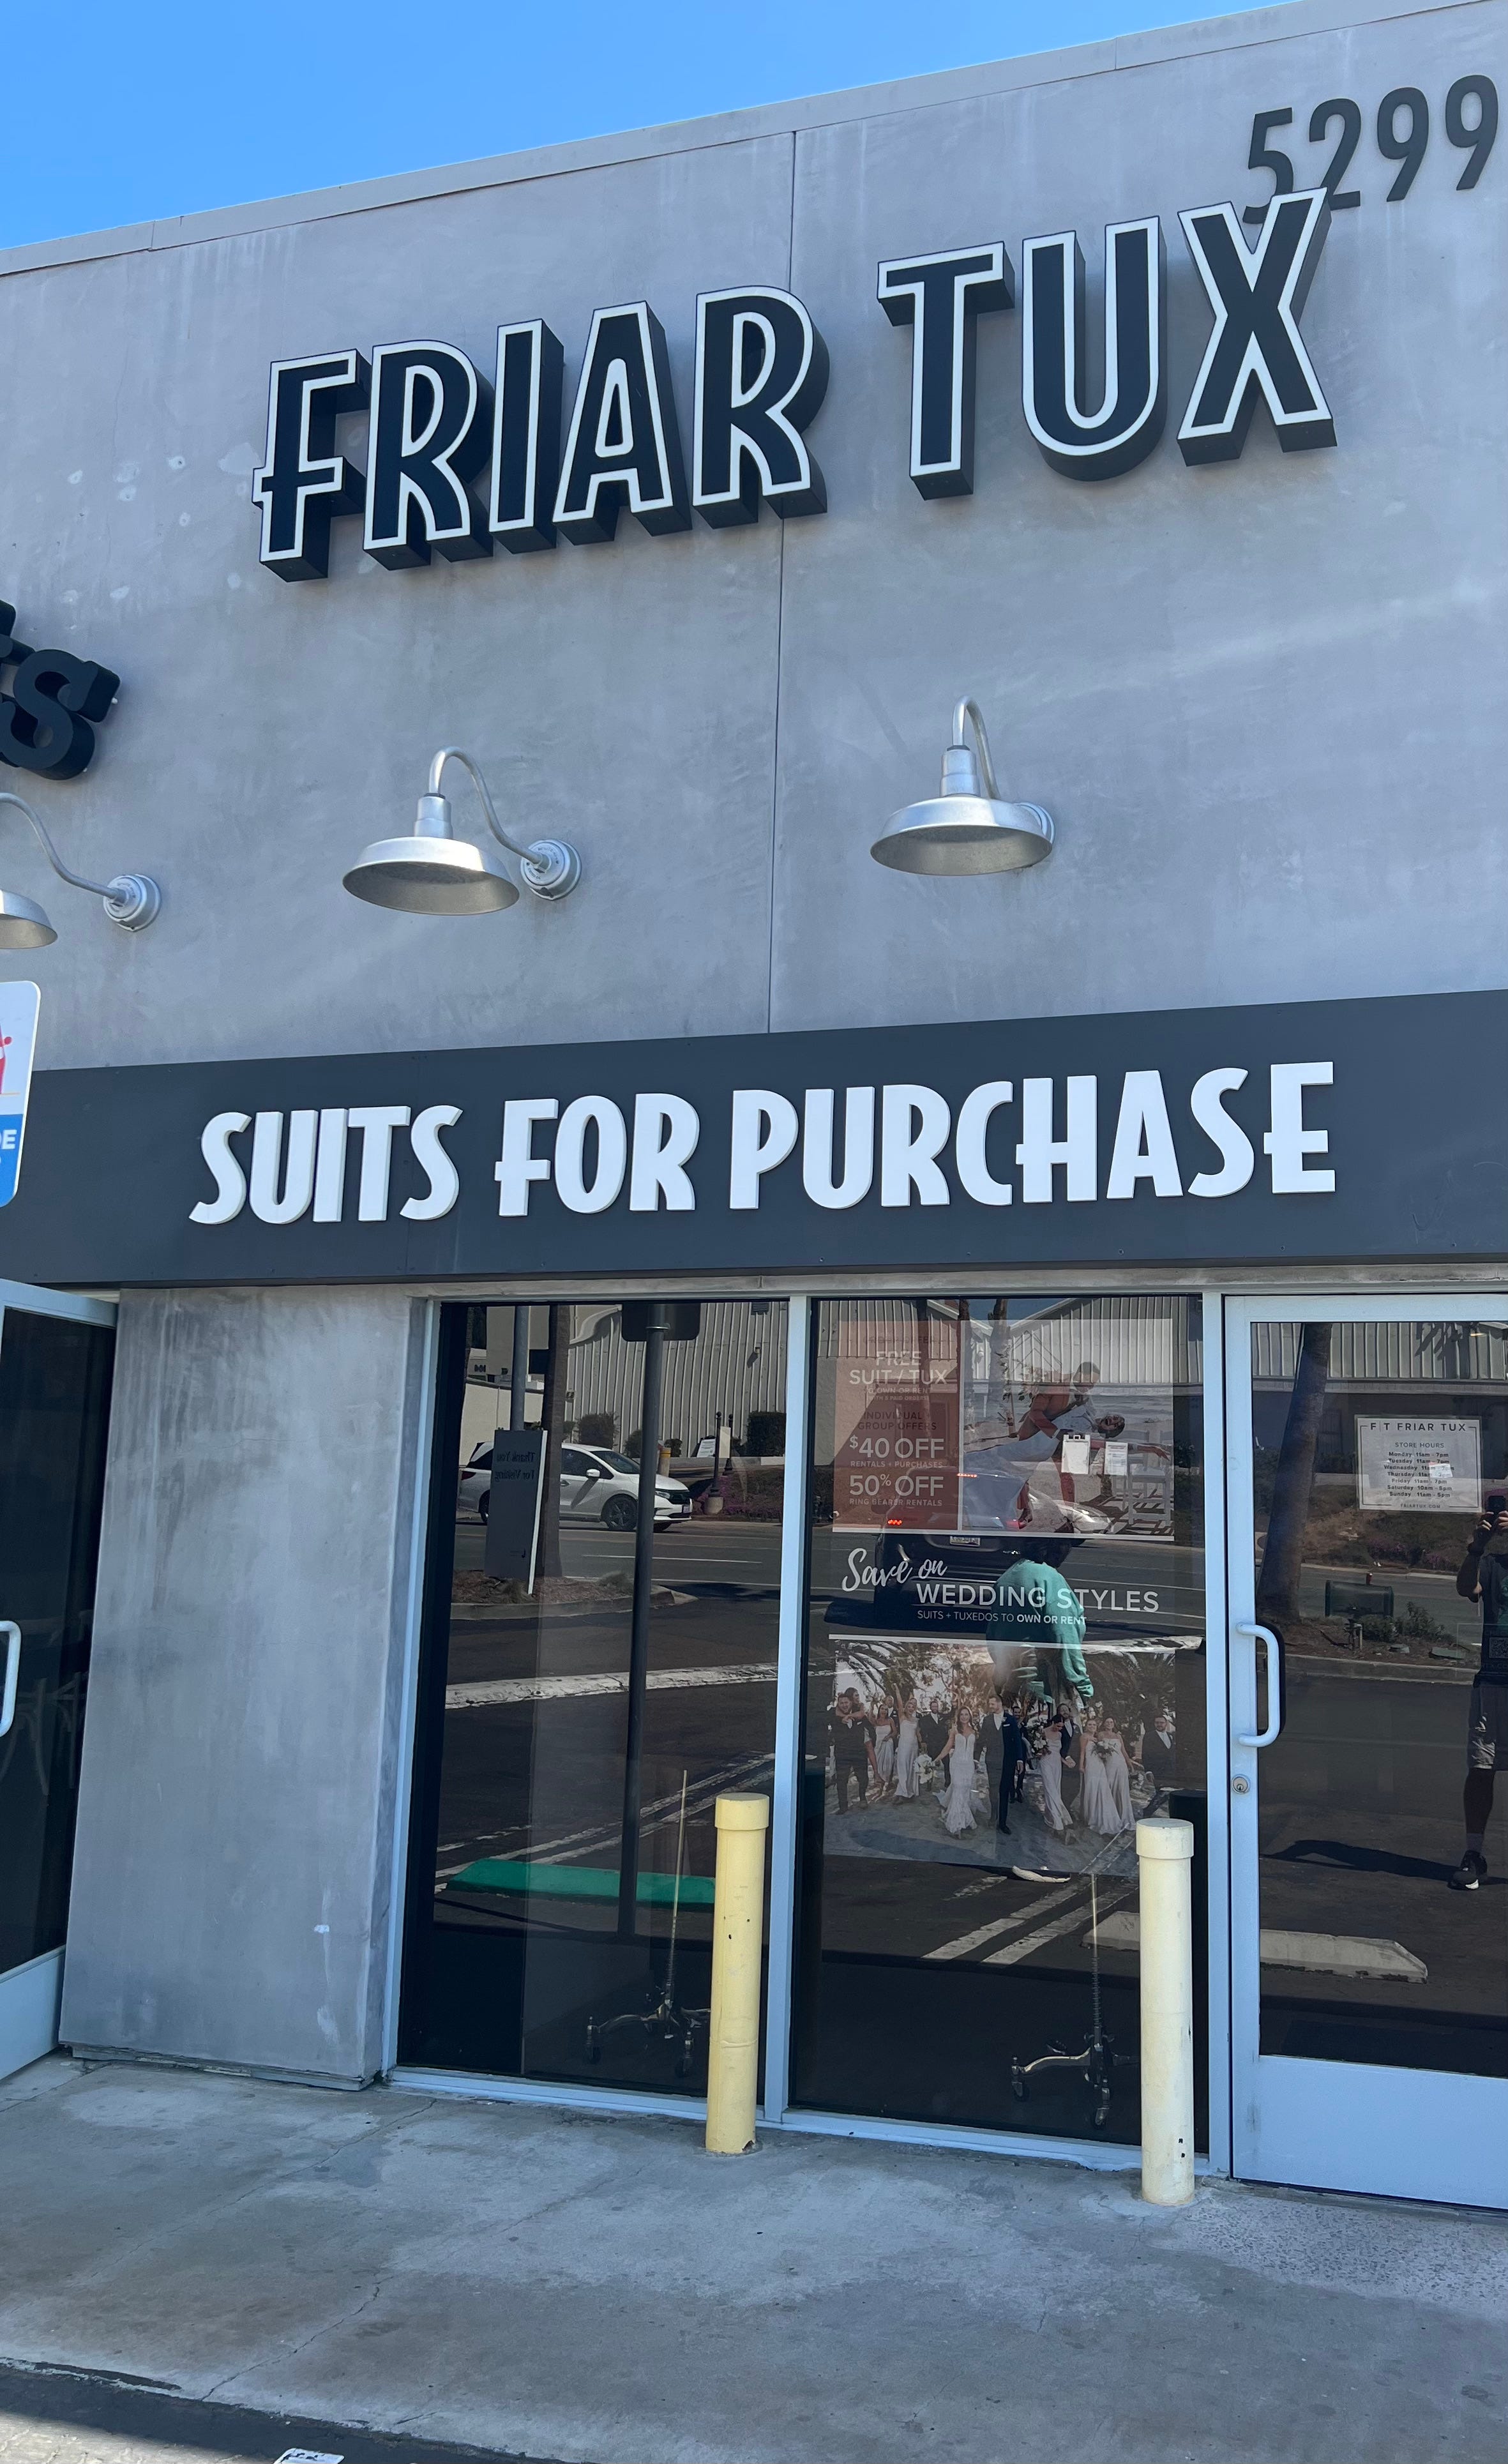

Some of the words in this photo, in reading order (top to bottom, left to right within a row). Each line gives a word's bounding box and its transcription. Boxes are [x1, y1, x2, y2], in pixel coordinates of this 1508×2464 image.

[1242, 73, 1499, 225] 5299
[253, 285, 829, 582] FRIAR
[877, 186, 1338, 501] TUX
[188, 1105, 464, 1225] SUITS
[495, 1092, 700, 1217] FOR
[729, 1061, 1336, 1210] PURCHASE
[876, 1350, 921, 1366] FREE
[849, 1369, 892, 1385] SUIT
[909, 1370, 947, 1385] TUX
[858, 1421, 894, 1430] GROUP
[898, 1422, 937, 1431] OFFERS
[1397, 1423, 1434, 1431] FRIAR
[849, 1434, 890, 1458] $40
[894, 1438, 944, 1459] OFF
[849, 1474, 892, 1496] 50%
[894, 1476, 944, 1497] OFF
[841, 1547, 913, 1592] Save
[918, 1559, 948, 1580] on
[916, 1583, 1046, 1608] WEDDING
[1057, 1588, 1159, 1613] STYLES
[917, 1610, 944, 1620] SUITS
[954, 1611, 999, 1622] TUXEDOS
[1000, 1613, 1014, 1622] TO
[1016, 1614, 1041, 1623] OWN
[1043, 1615, 1057, 1624] OR
[1060, 1615, 1087, 1625] RENT
